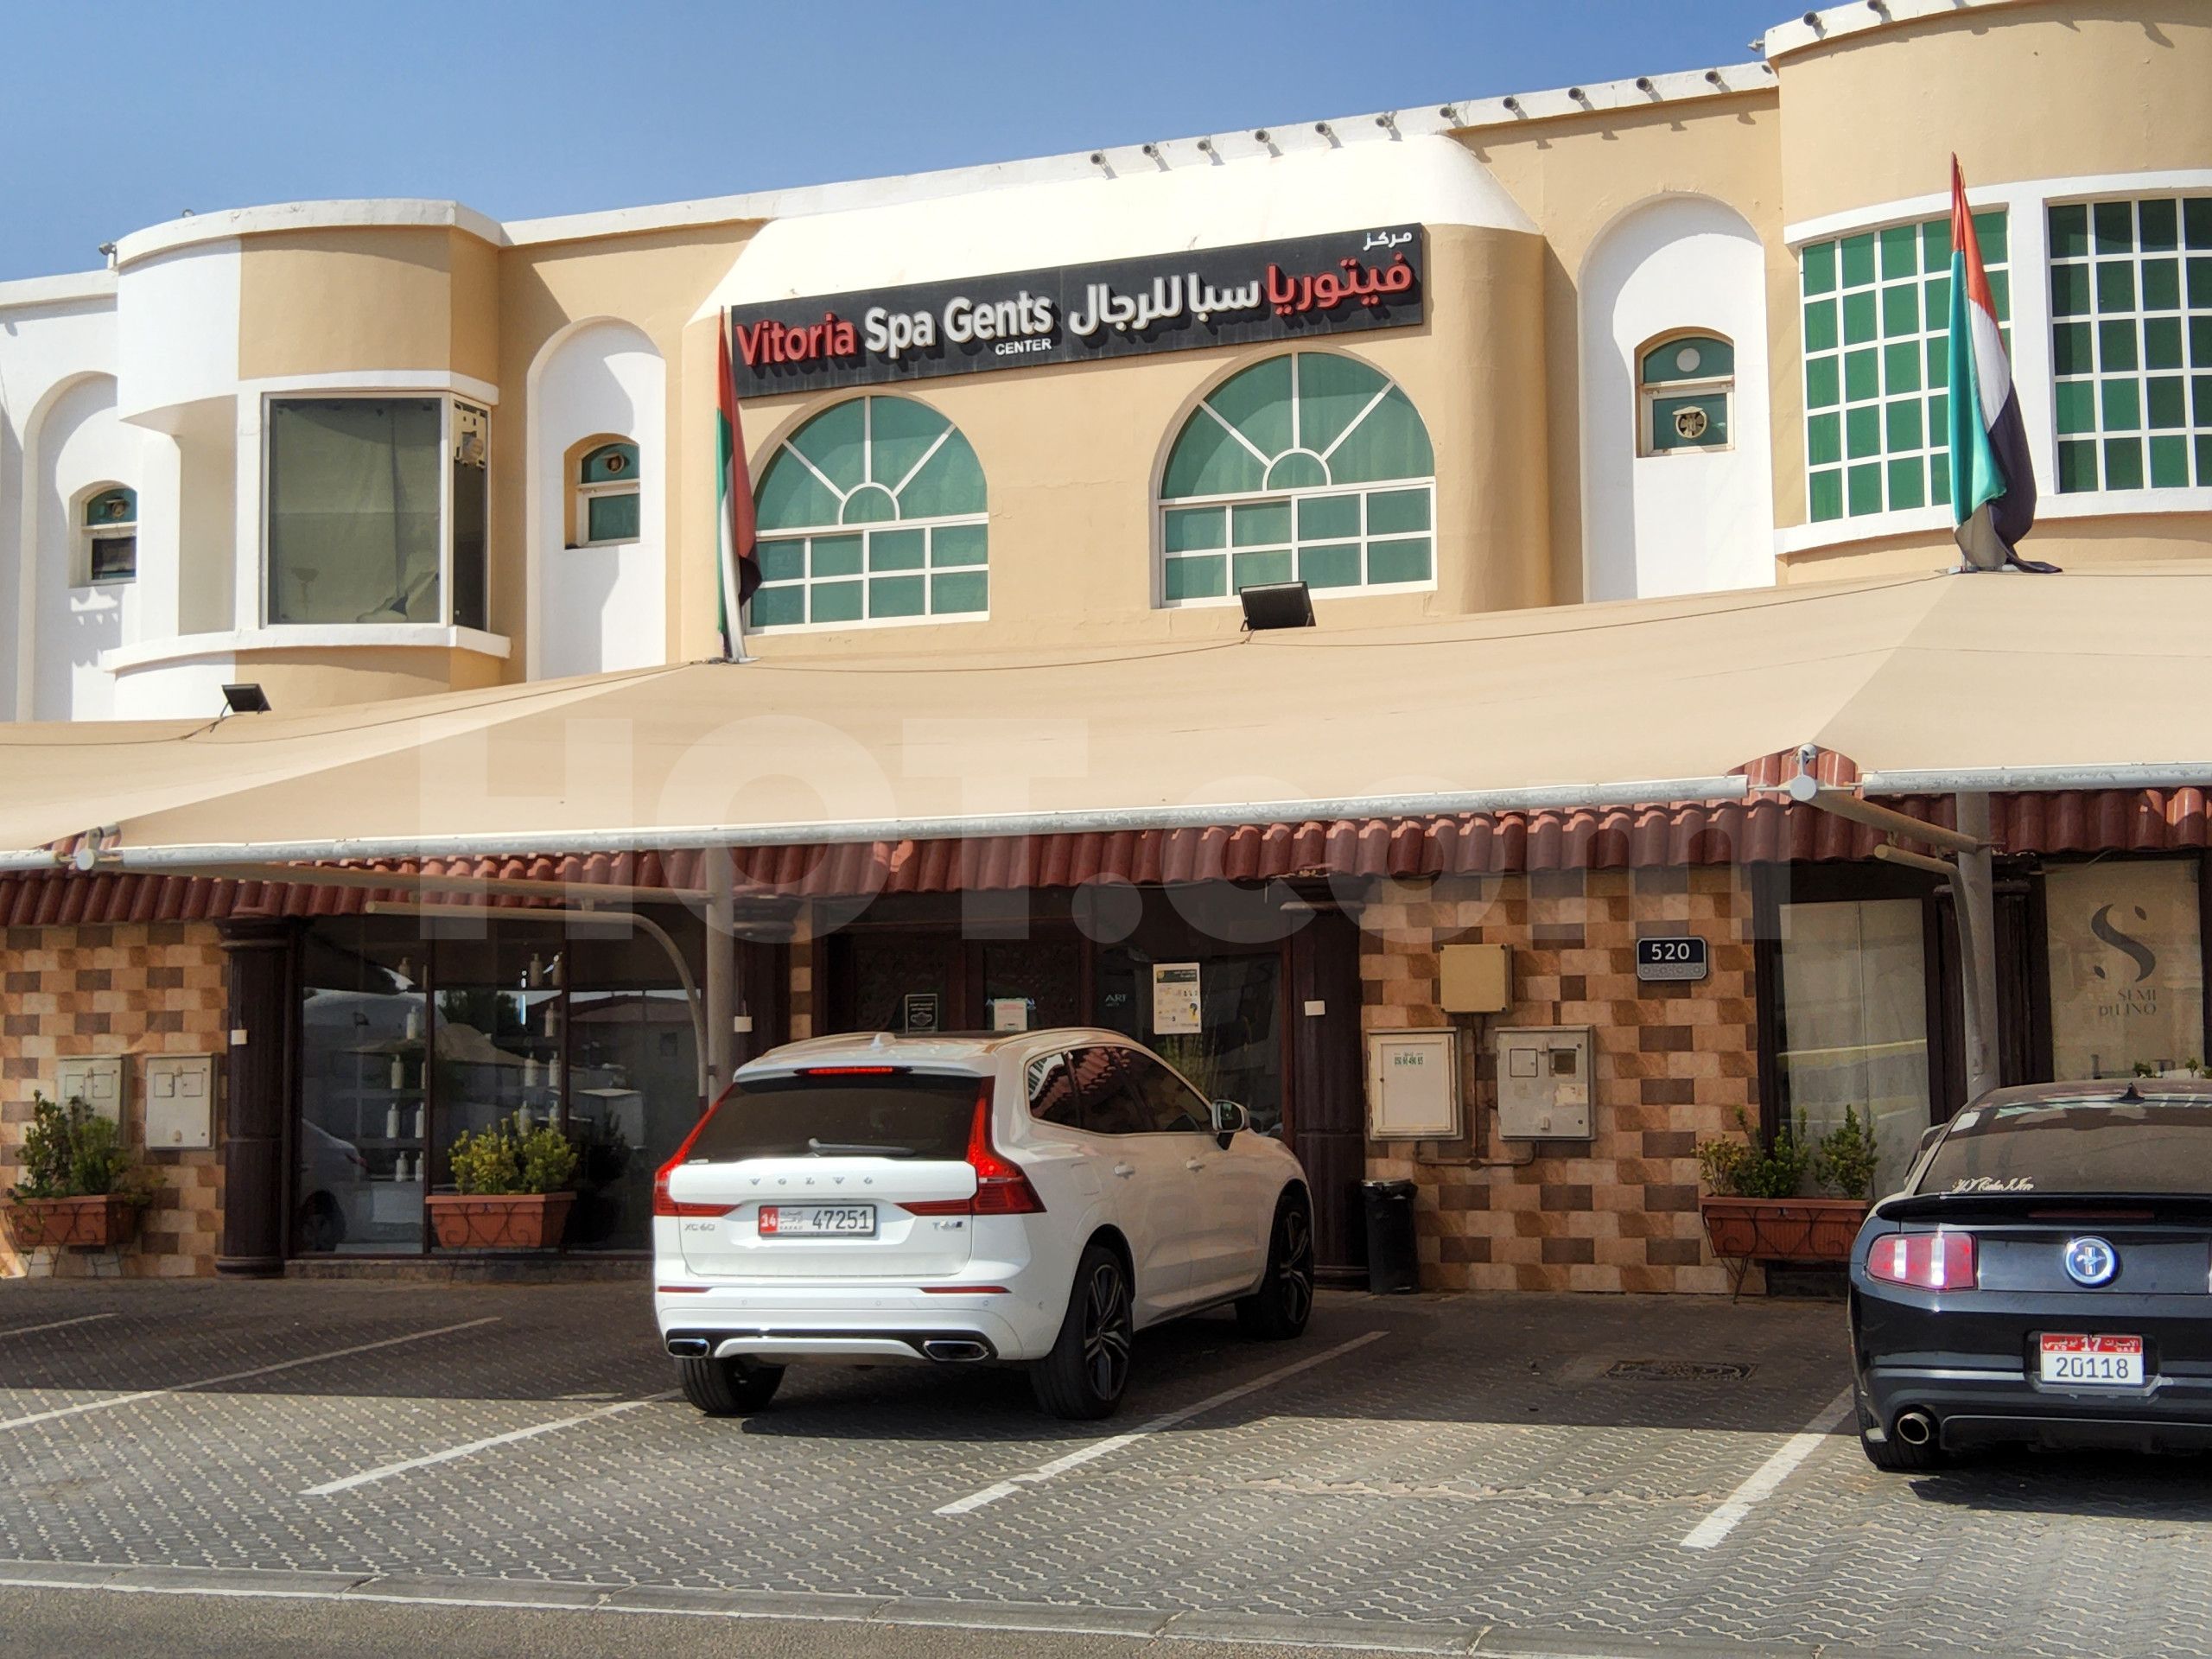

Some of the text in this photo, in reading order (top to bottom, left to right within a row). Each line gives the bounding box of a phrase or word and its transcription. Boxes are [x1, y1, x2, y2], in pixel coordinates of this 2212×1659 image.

[1363, 232, 1413, 251] مركز
[1069, 251, 1414, 336] فيتوريا سبا للرجال
[735, 290, 1054, 366] Vitoria Spa Gents
[995, 338, 1052, 357] CENTER
[1651, 943, 1690, 961] 520
[760, 1214, 776, 1227] 14
[812, 1211, 870, 1230] 47251
[2081, 1337, 2101, 1352] 17
[2056, 1357, 2129, 1379] 20118
